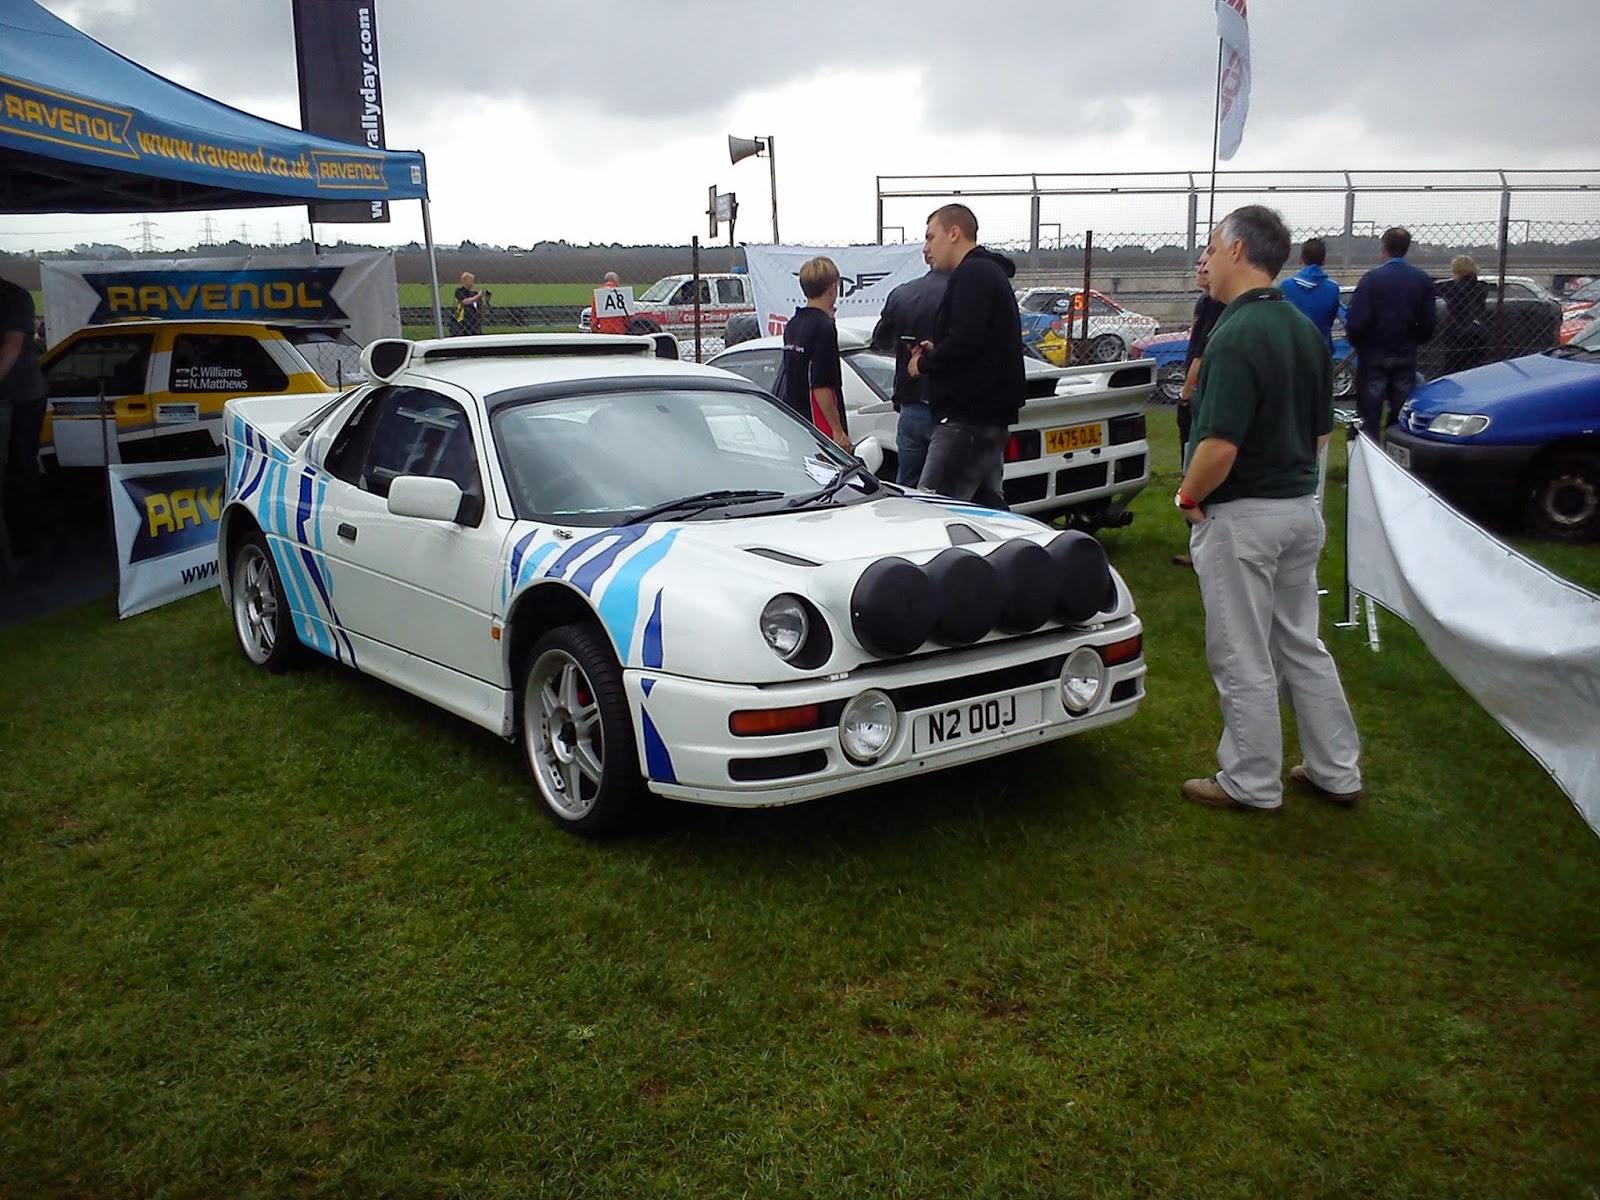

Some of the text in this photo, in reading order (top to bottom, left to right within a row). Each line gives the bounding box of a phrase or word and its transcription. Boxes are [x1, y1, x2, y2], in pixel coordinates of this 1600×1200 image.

[5, 94, 380, 180] RAVENOL www.ravenol.co.uk RAVENOL
[106, 282, 323, 312] RAVENOL
[605, 294, 625, 310] A8
[189, 378, 248, 390] N.Matthews
[144, 485, 223, 538] RAV
[181, 560, 219, 584] www
[929, 709, 961, 744] N2
